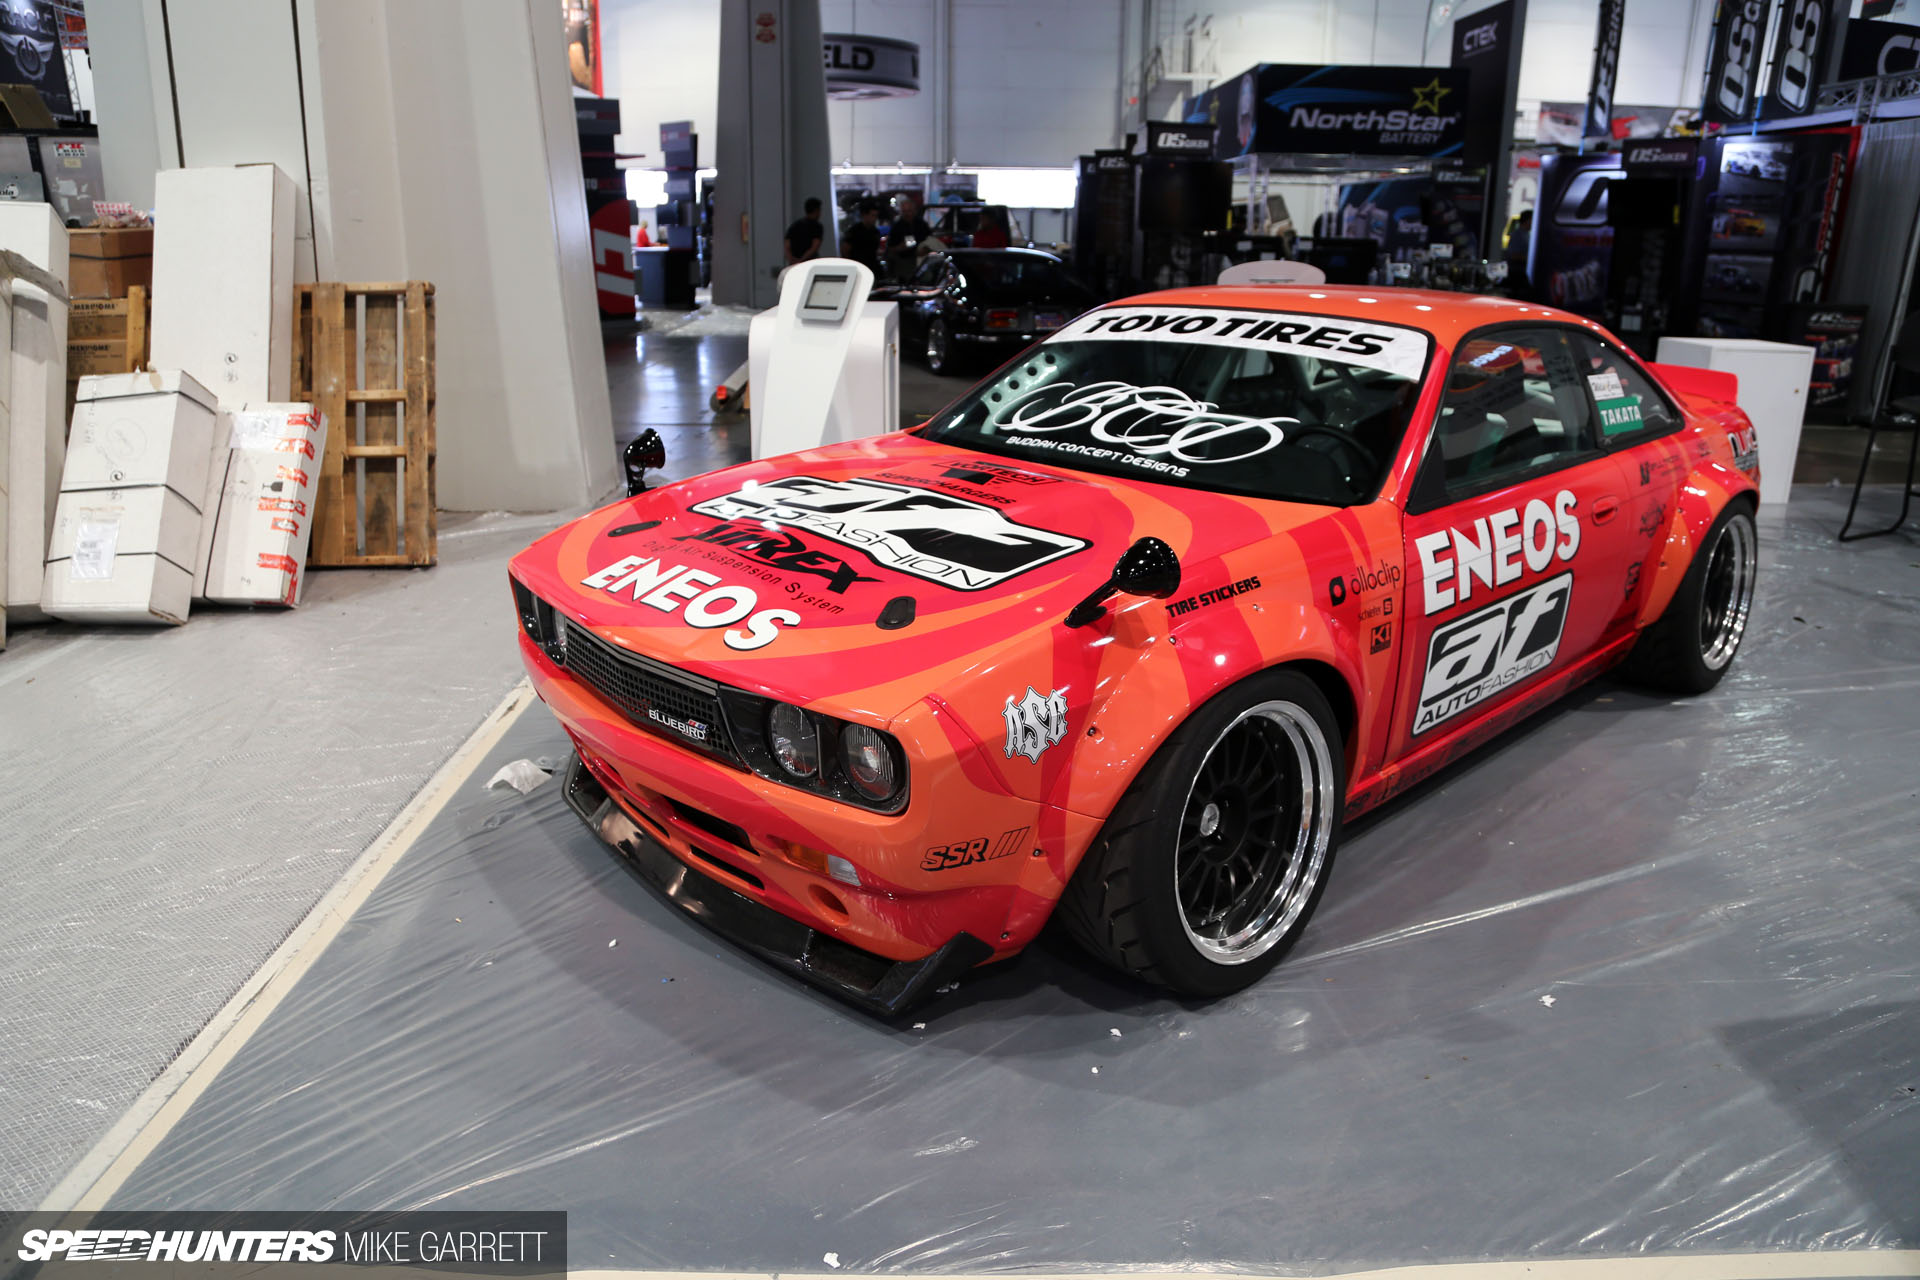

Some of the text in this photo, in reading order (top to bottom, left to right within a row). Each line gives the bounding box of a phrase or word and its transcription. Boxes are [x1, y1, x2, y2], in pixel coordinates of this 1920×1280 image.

[1463, 22, 1498, 51] CTEK
[1290, 108, 1456, 131] NorthStar
[1379, 132, 1442, 144] BATTERY
[1083, 314, 1396, 356] TOYO TIRES
[1600, 405, 1642, 426] TAKATA
[1006, 436, 1191, 478] BUDDAH CONCEPT DESIGNS
[1415, 489, 1581, 617] ENEOS
[580, 555, 801, 651] ENEOS
[701, 550, 783, 585] Suspension
[785, 581, 845, 615] System
[1165, 575, 1262, 618] TIRE STICKERS
[1417, 647, 1558, 731] AUTOFASHION
[648, 708, 706, 740] BLUEBIRD
[920, 837, 990, 872] SSR
